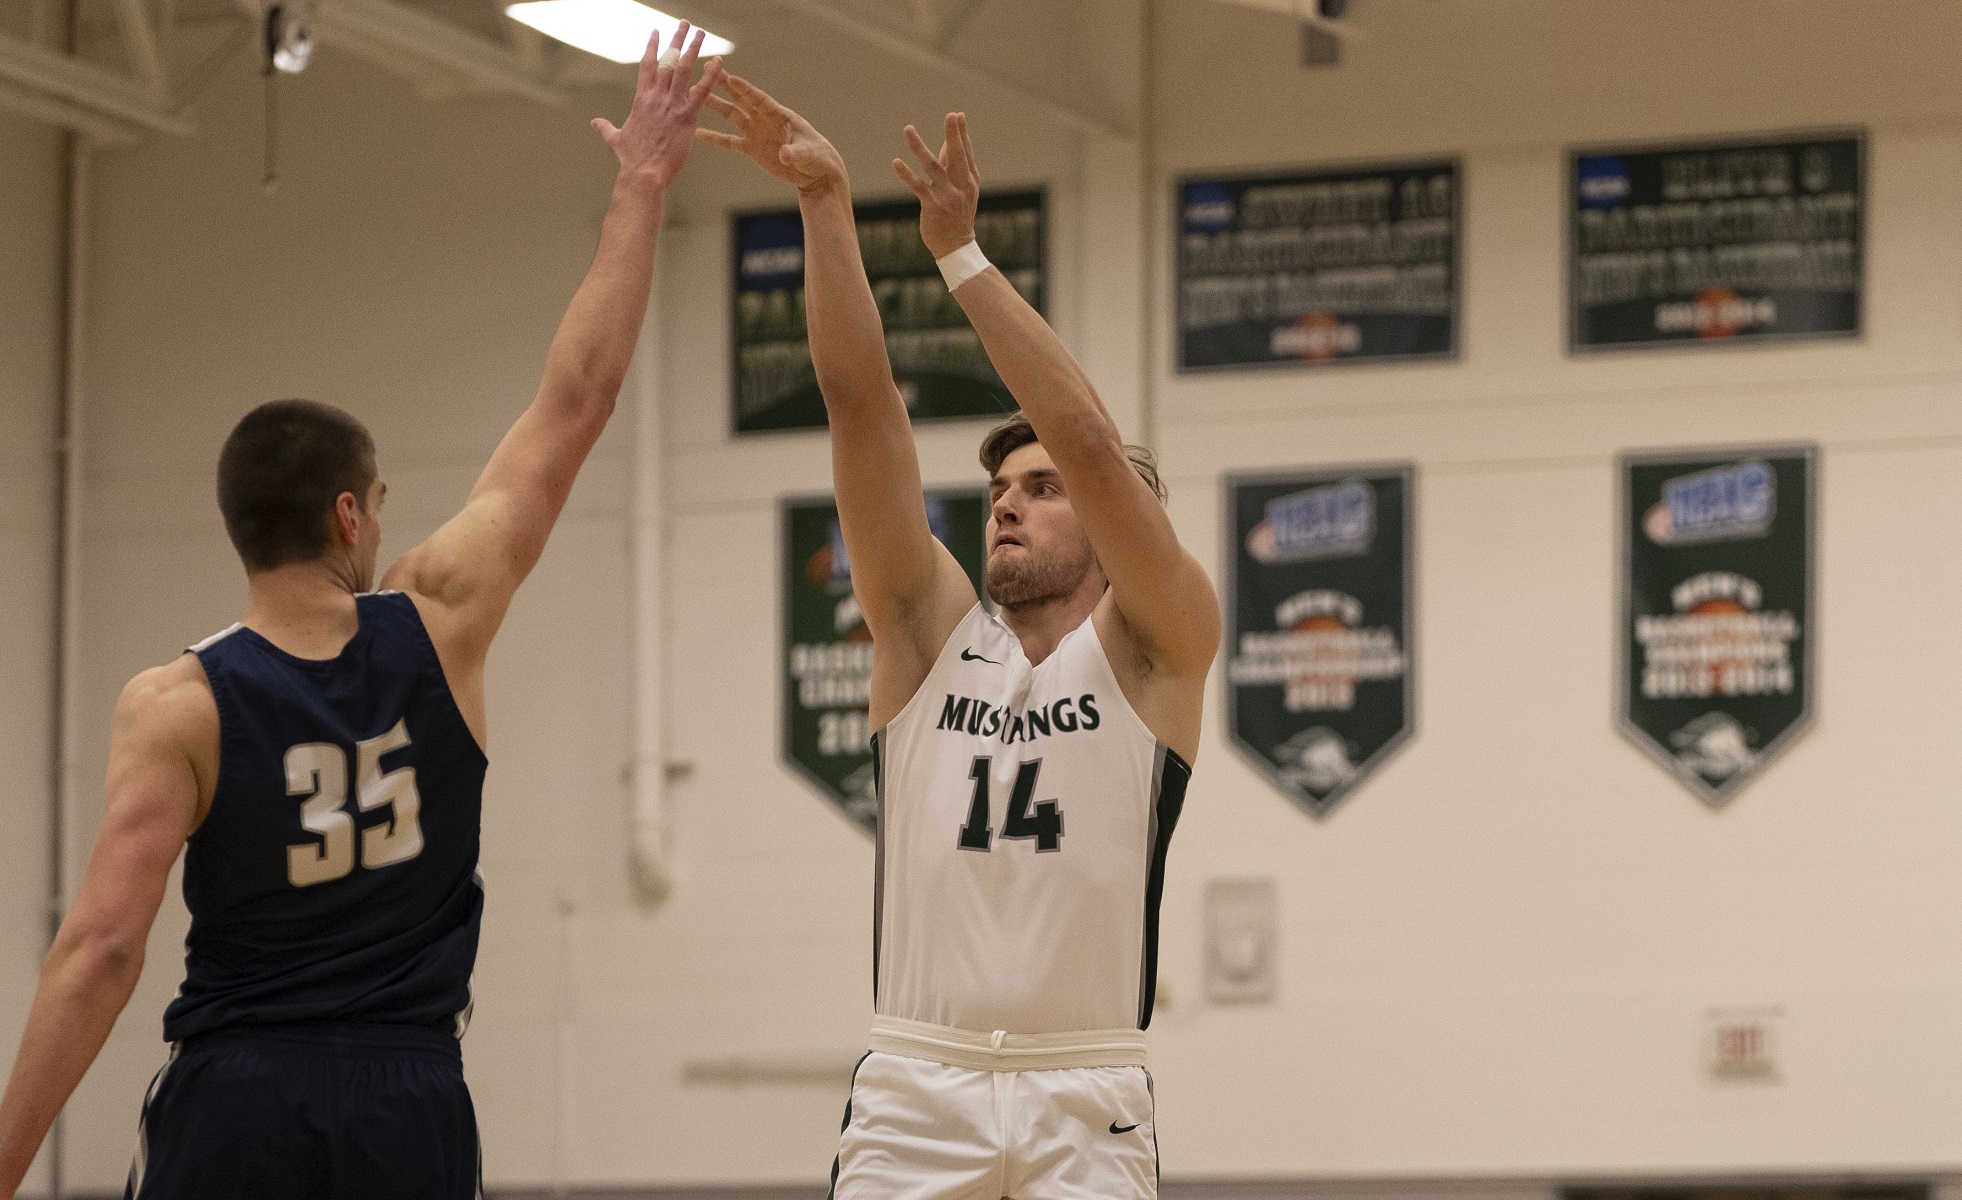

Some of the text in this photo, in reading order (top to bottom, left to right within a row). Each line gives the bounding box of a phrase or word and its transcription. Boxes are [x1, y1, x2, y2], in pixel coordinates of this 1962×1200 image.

[1638, 613, 1796, 641] BASKETBALL
[936, 693, 1101, 745] MUSTANGS
[283, 715, 425, 888] 35
[956, 754, 1066, 854] 14
